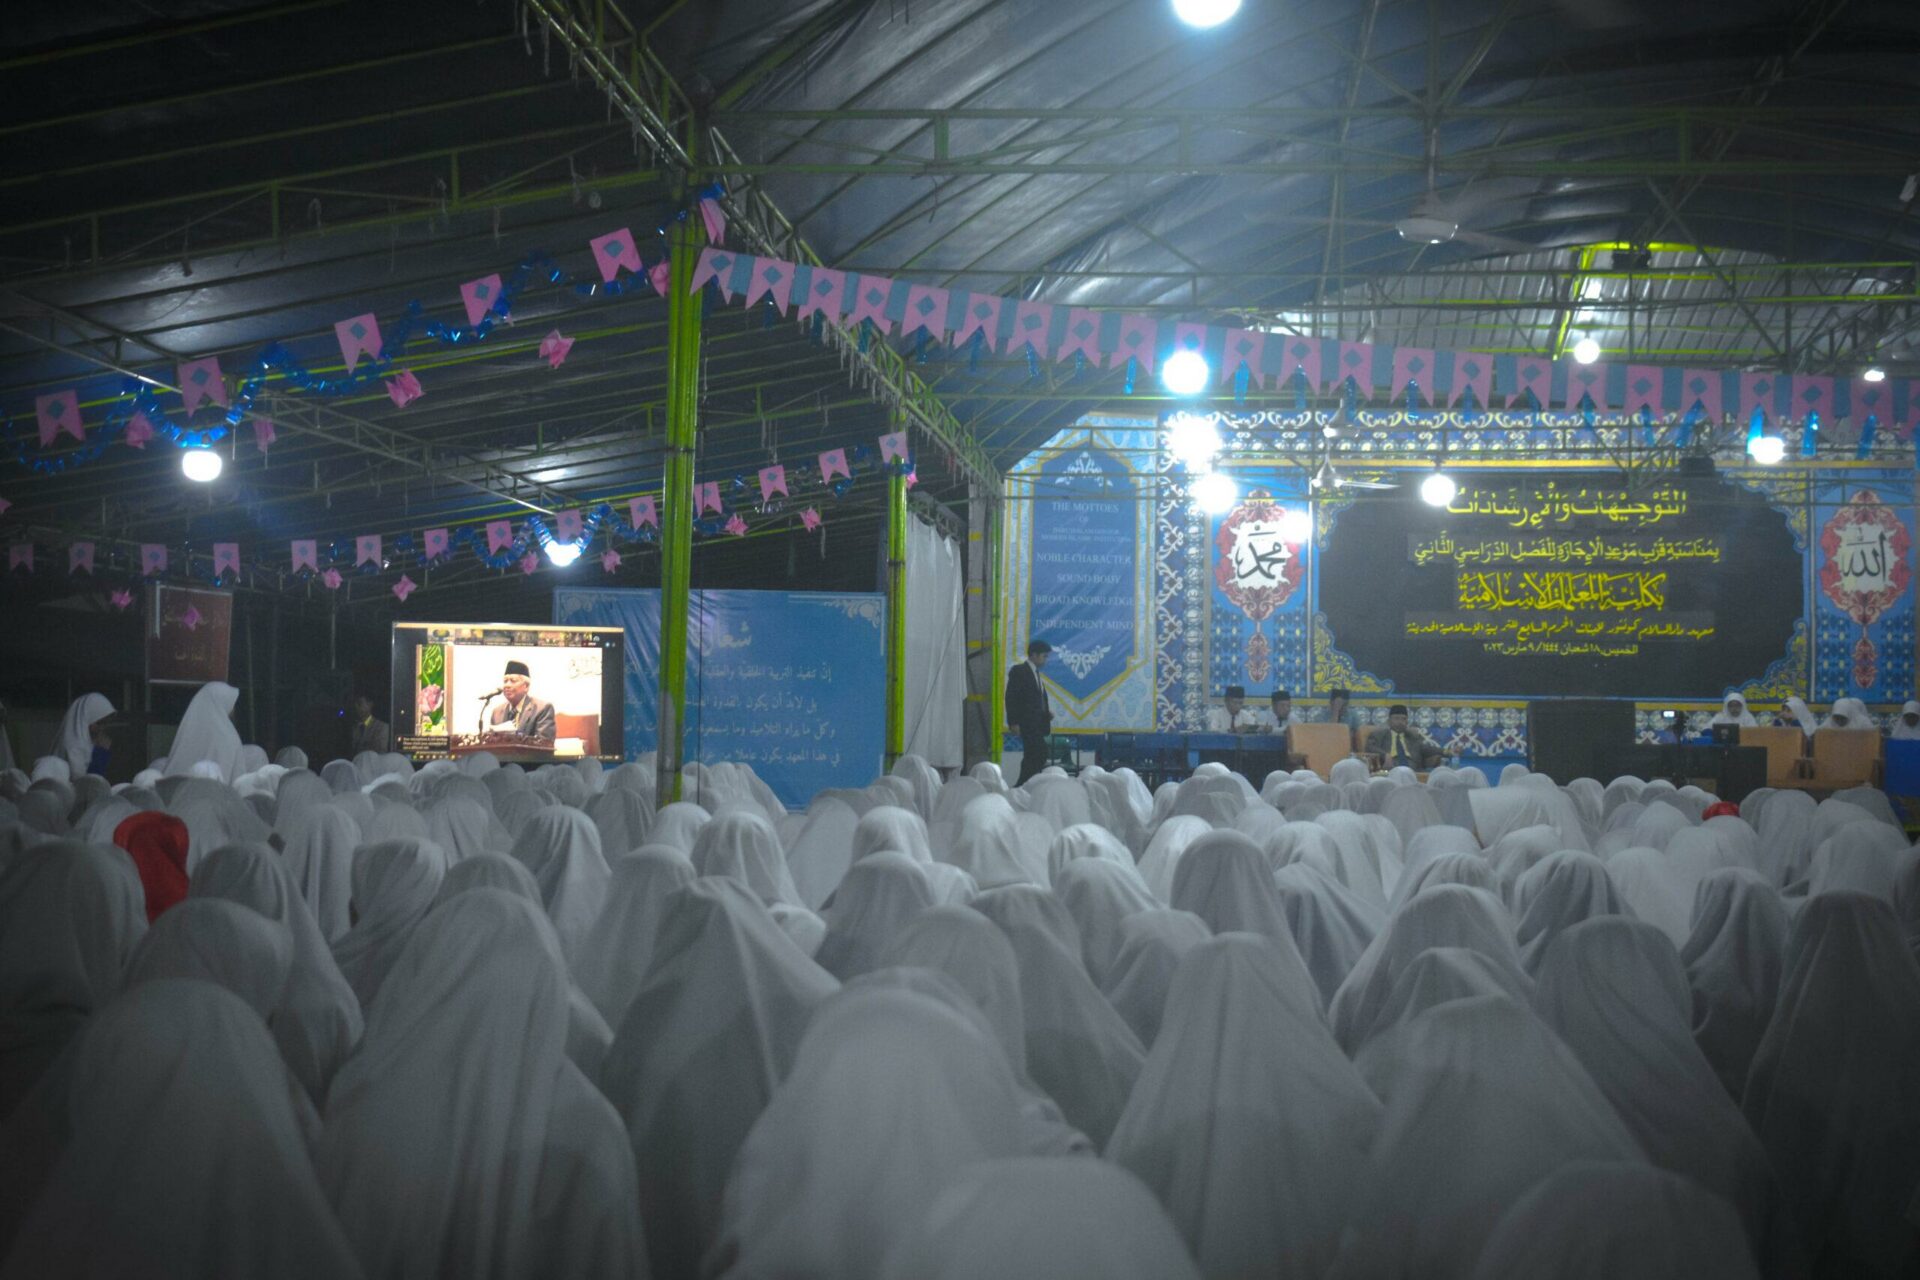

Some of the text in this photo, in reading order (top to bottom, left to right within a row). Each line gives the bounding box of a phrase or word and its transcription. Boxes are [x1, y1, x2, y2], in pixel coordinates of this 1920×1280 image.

[1052, 502, 1119, 513] THE MOTTOES
[1037, 553, 1132, 565] NOBLE CHARACTER
[1057, 573, 1121, 584] SOUND BODY
[1036, 594, 1070, 604] BROAD
[1036, 619, 1133, 630] INDEPENDENT MIND
